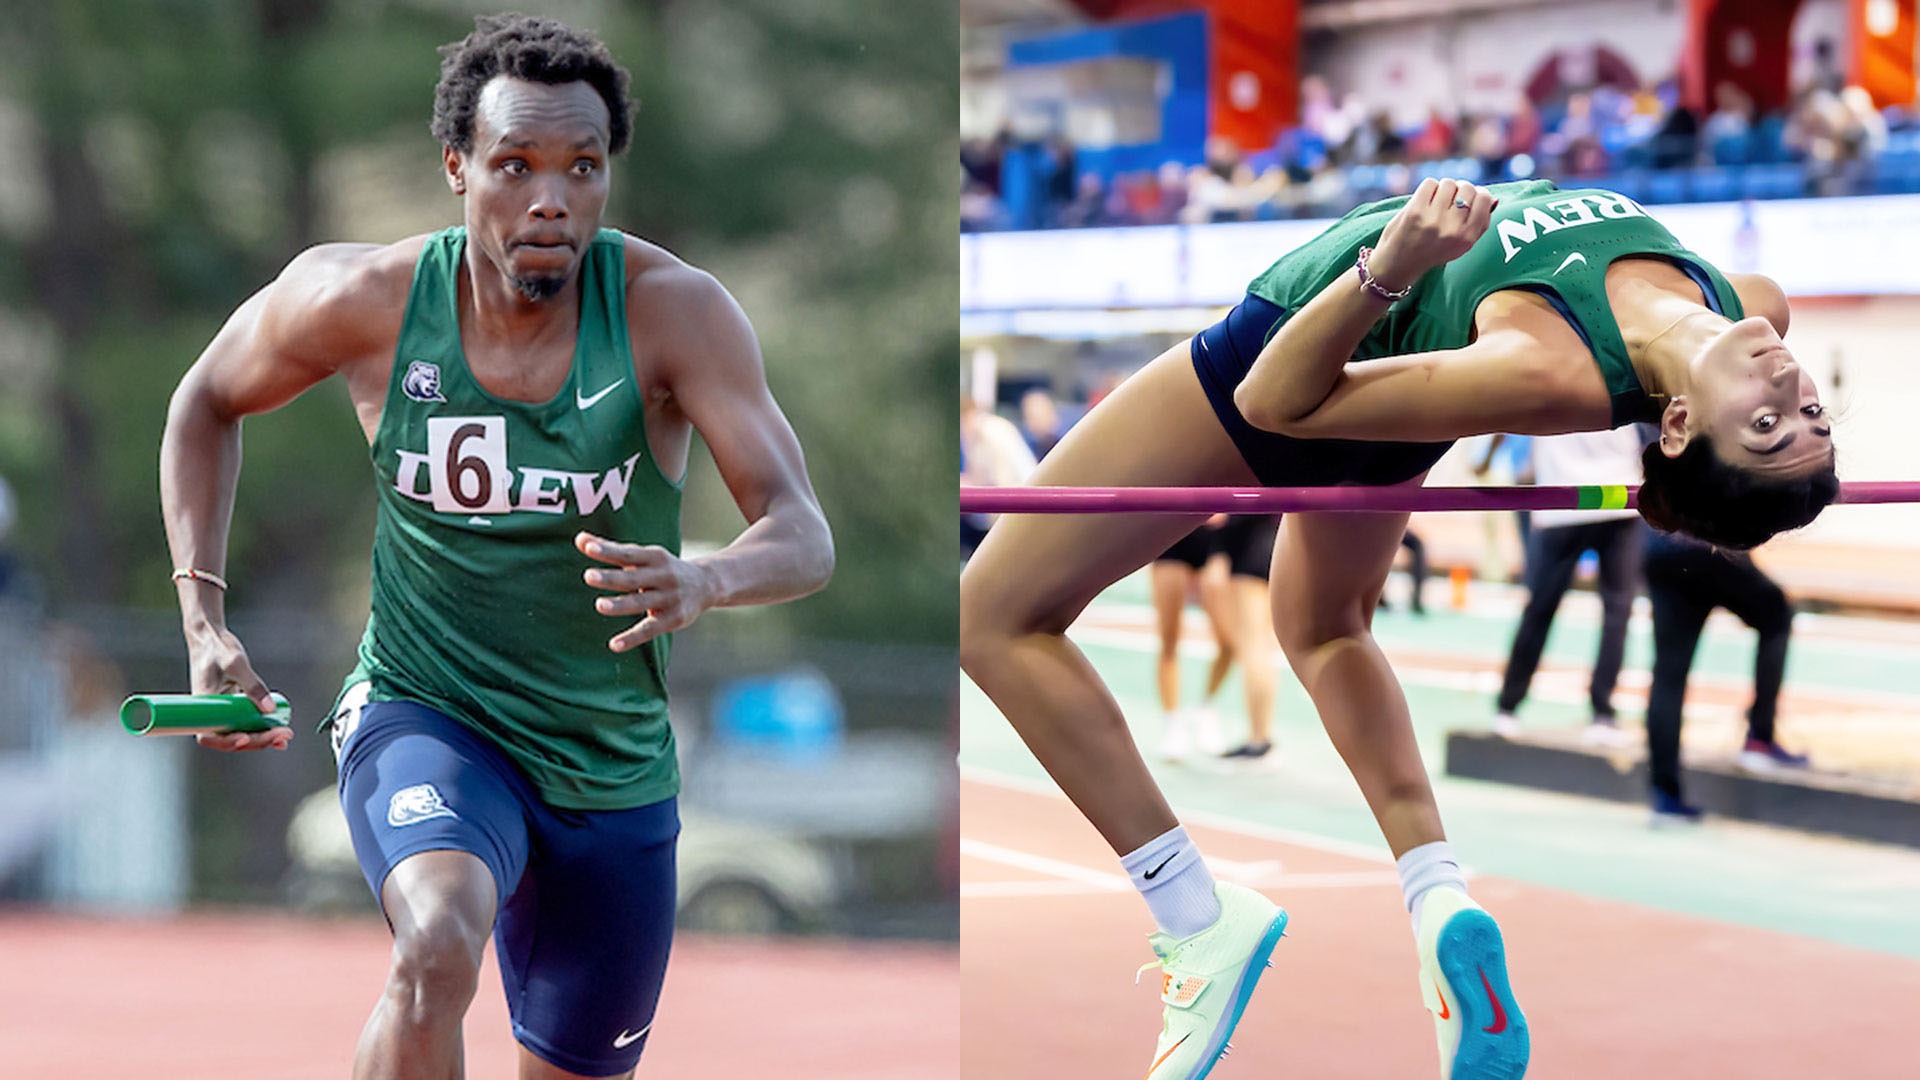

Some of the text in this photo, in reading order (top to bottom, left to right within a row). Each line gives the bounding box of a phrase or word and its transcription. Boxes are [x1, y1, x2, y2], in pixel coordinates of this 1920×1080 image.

[1496, 192, 1650, 263] REW
[393, 449, 641, 515] DEW
[446, 424, 492, 508] 6
